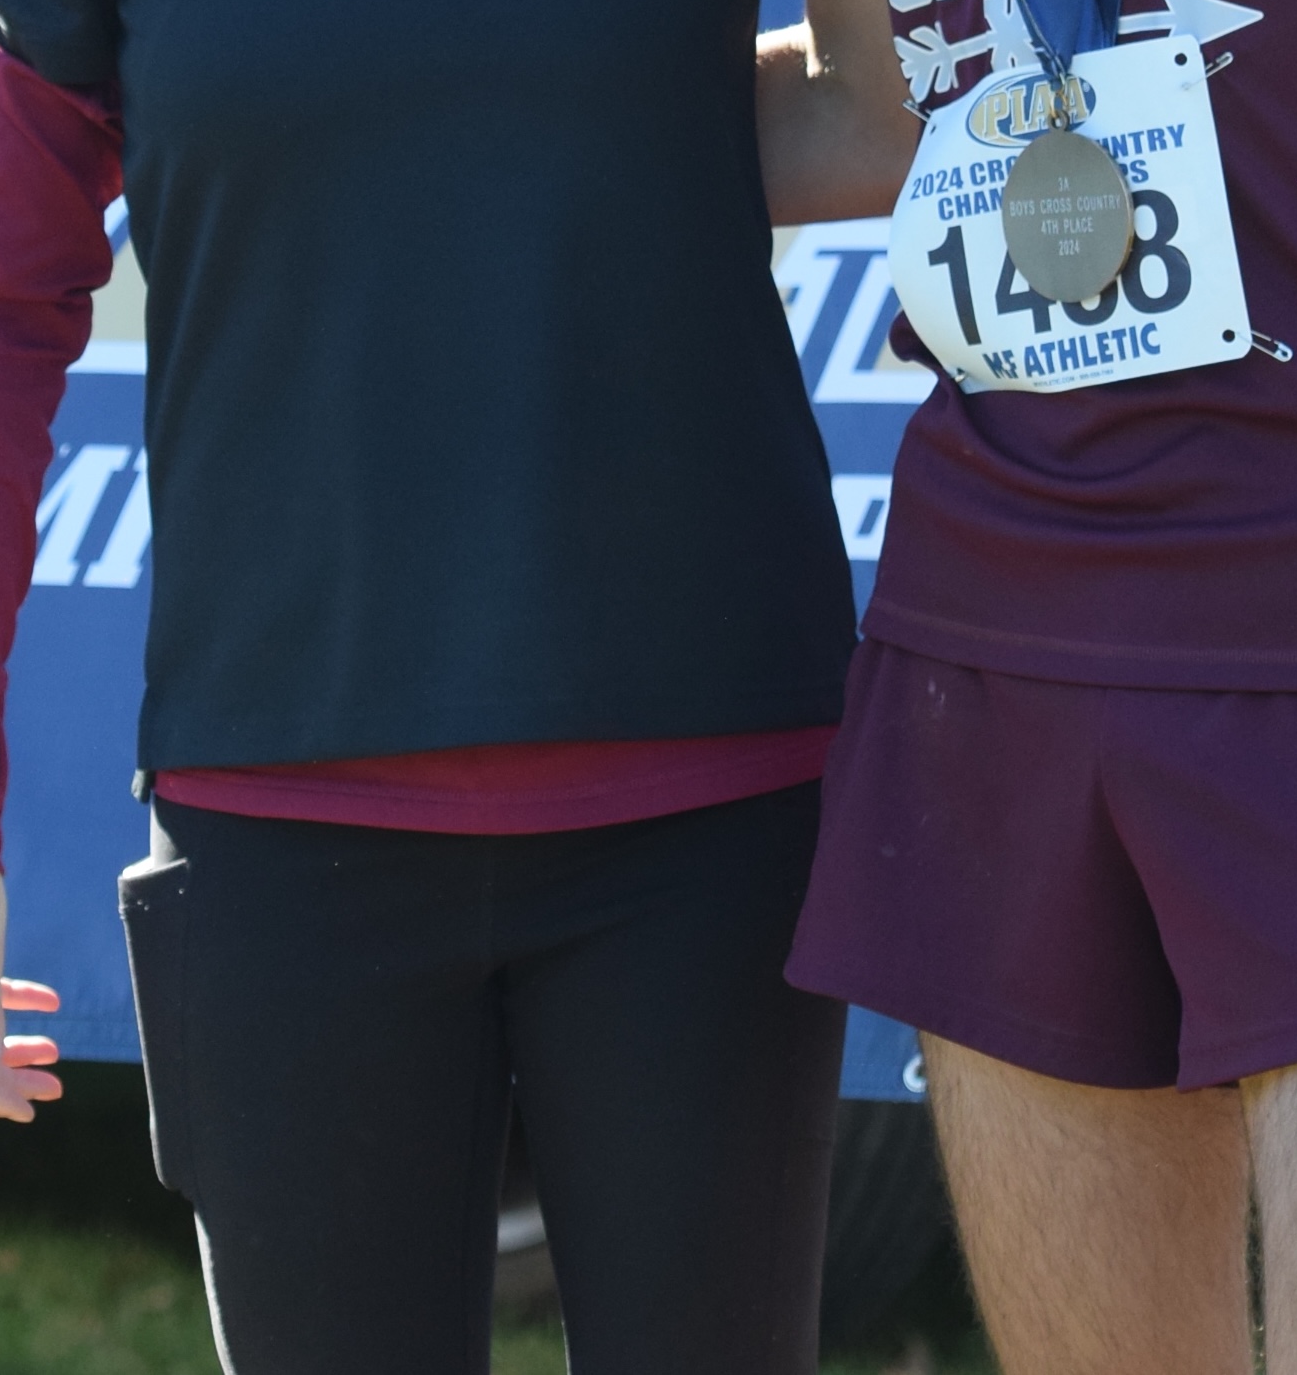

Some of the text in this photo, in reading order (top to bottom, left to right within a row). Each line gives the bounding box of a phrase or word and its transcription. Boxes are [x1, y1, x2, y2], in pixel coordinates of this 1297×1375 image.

[910, 166, 964, 200] 2024
[1057, 176, 1070, 192] 3A
[1009, 199, 1035, 217] BOYS
[1039, 197, 1072, 214] CROSS
[1076, 194, 1121, 212] COUNTRY
[1041, 216, 1095, 235] 4TH PLACE
[1058, 238, 1081, 256] 2024
[1023, 322, 1161, 378] ATHLETIC
